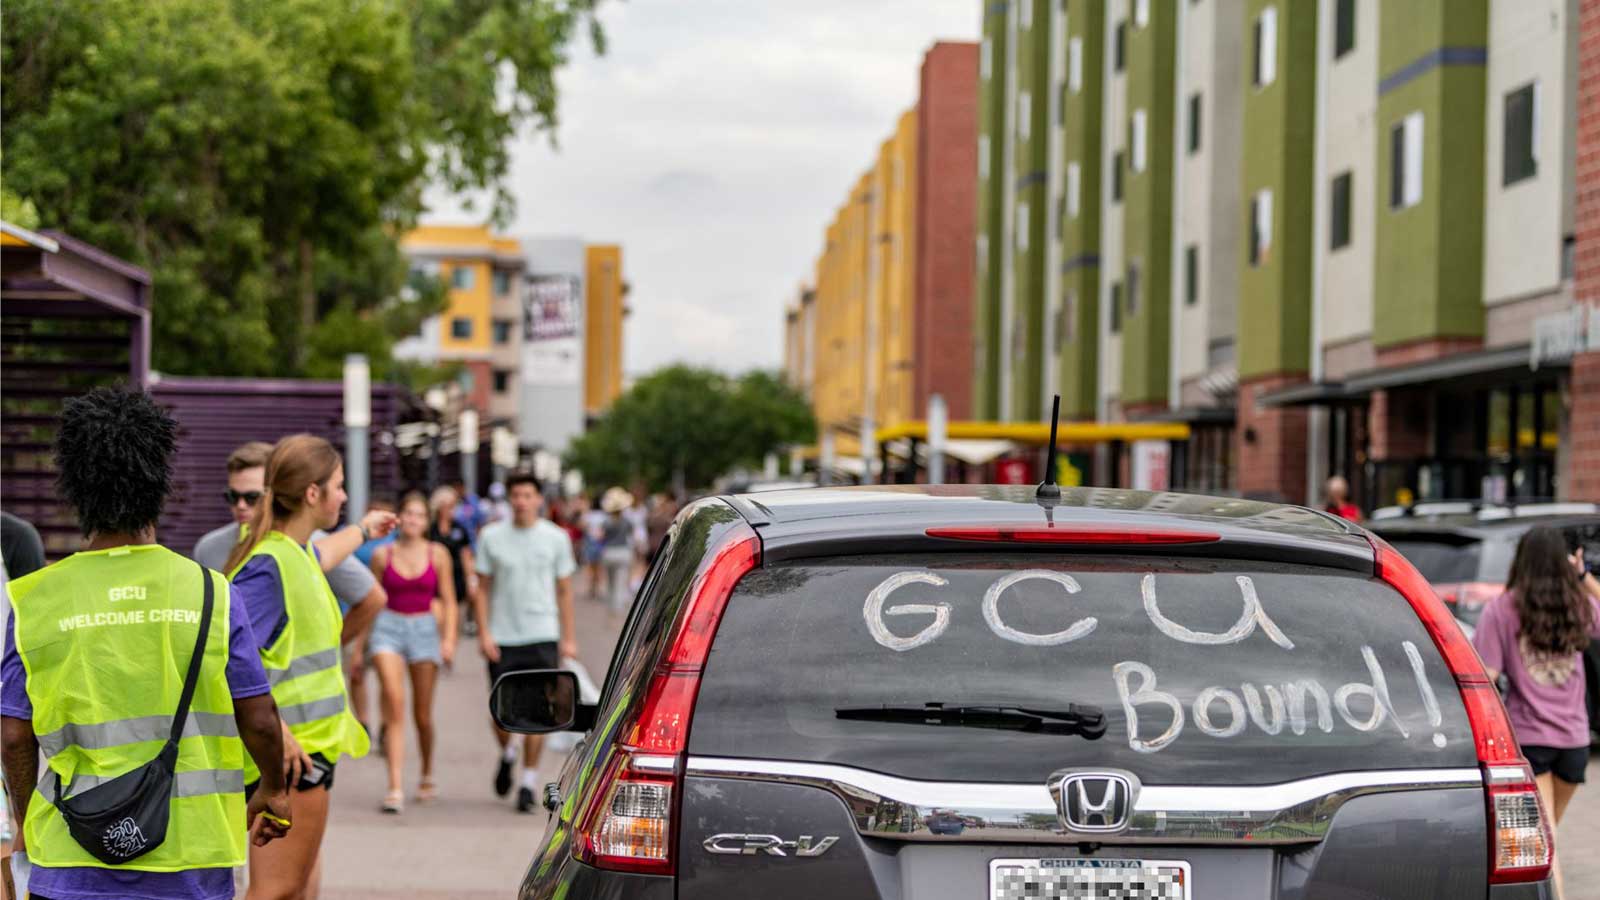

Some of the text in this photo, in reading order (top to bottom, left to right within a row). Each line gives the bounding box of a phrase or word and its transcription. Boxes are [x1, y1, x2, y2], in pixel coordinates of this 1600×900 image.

[108, 586, 147, 601] GCU
[59, 608, 201, 632] WELCOME CREW
[1112, 640, 1448, 753] Bound!
[703, 833, 840, 856] CR-V
[1041, 859, 1141, 868] CHULA VISTA
